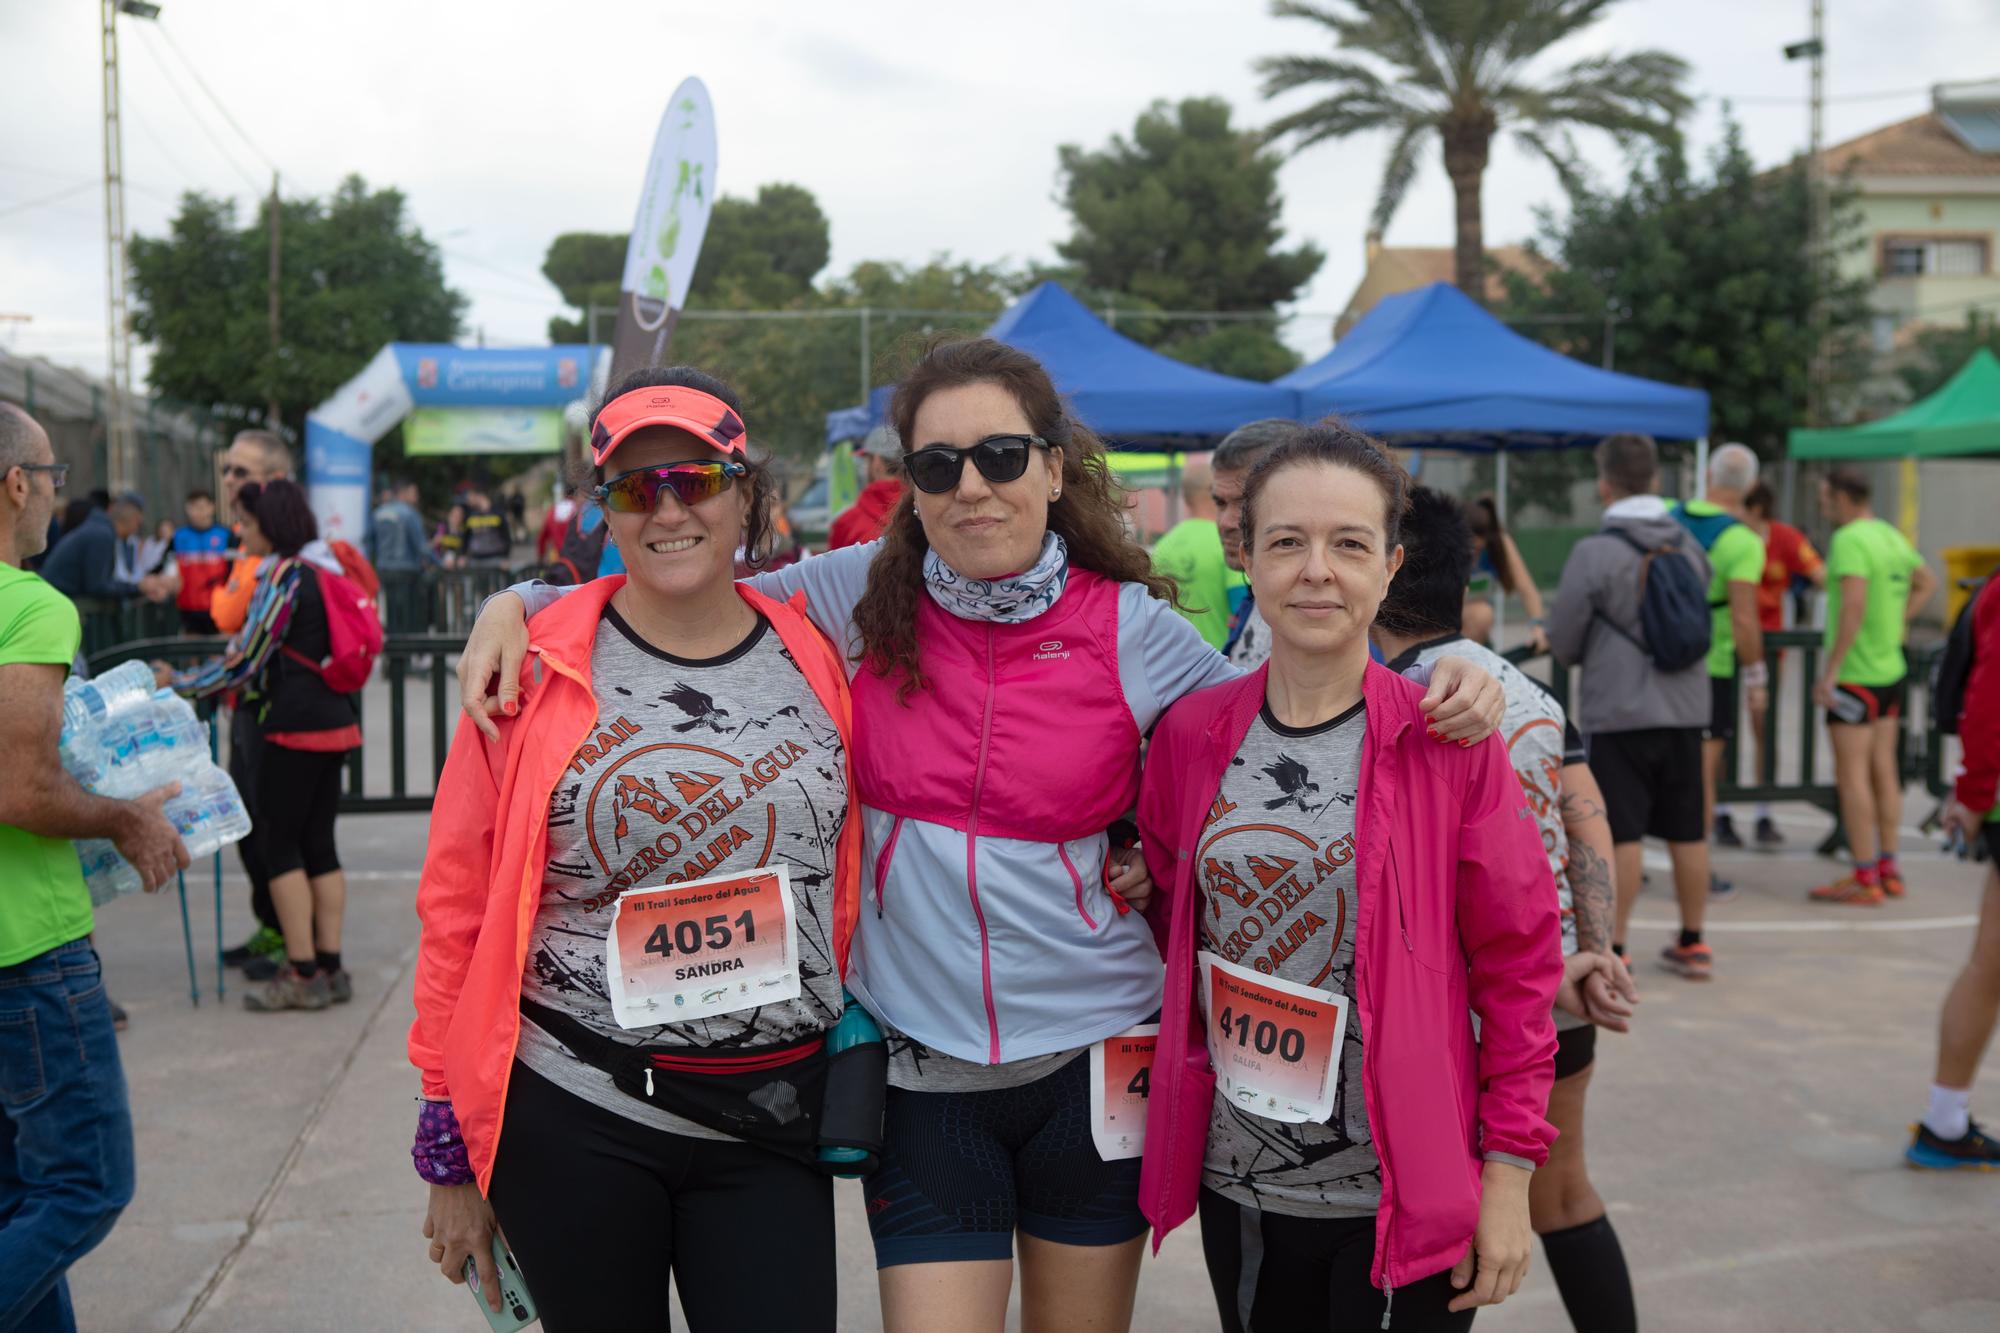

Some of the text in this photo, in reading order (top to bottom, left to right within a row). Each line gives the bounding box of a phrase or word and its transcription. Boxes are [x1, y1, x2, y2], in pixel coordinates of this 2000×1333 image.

[1033, 650, 1070, 660] Kalenji
[567, 716, 643, 775] TRAIL
[677, 787, 743, 842] DEL
[739, 739, 808, 798] AGUA
[665, 824, 753, 884] GALIFA
[634, 885, 760, 911] III Trail Sendero del Agua
[1257, 873, 1315, 927] DEL
[645, 910, 755, 957] 4051
[1253, 910, 1327, 975] GALIFA
[675, 957, 744, 981] SANDRA
[1224, 980, 1239, 994] Trail
[1241, 987, 1273, 1006] Sendero
[1275, 998, 1289, 1011] del
[1291, 1003, 1318, 1018] Agua
[1122, 1044, 1132, 1053] III
[1220, 1006, 1306, 1063] 4100
[1128, 1066, 1150, 1099] 4
[1232, 1053, 1262, 1073] GALIFA
